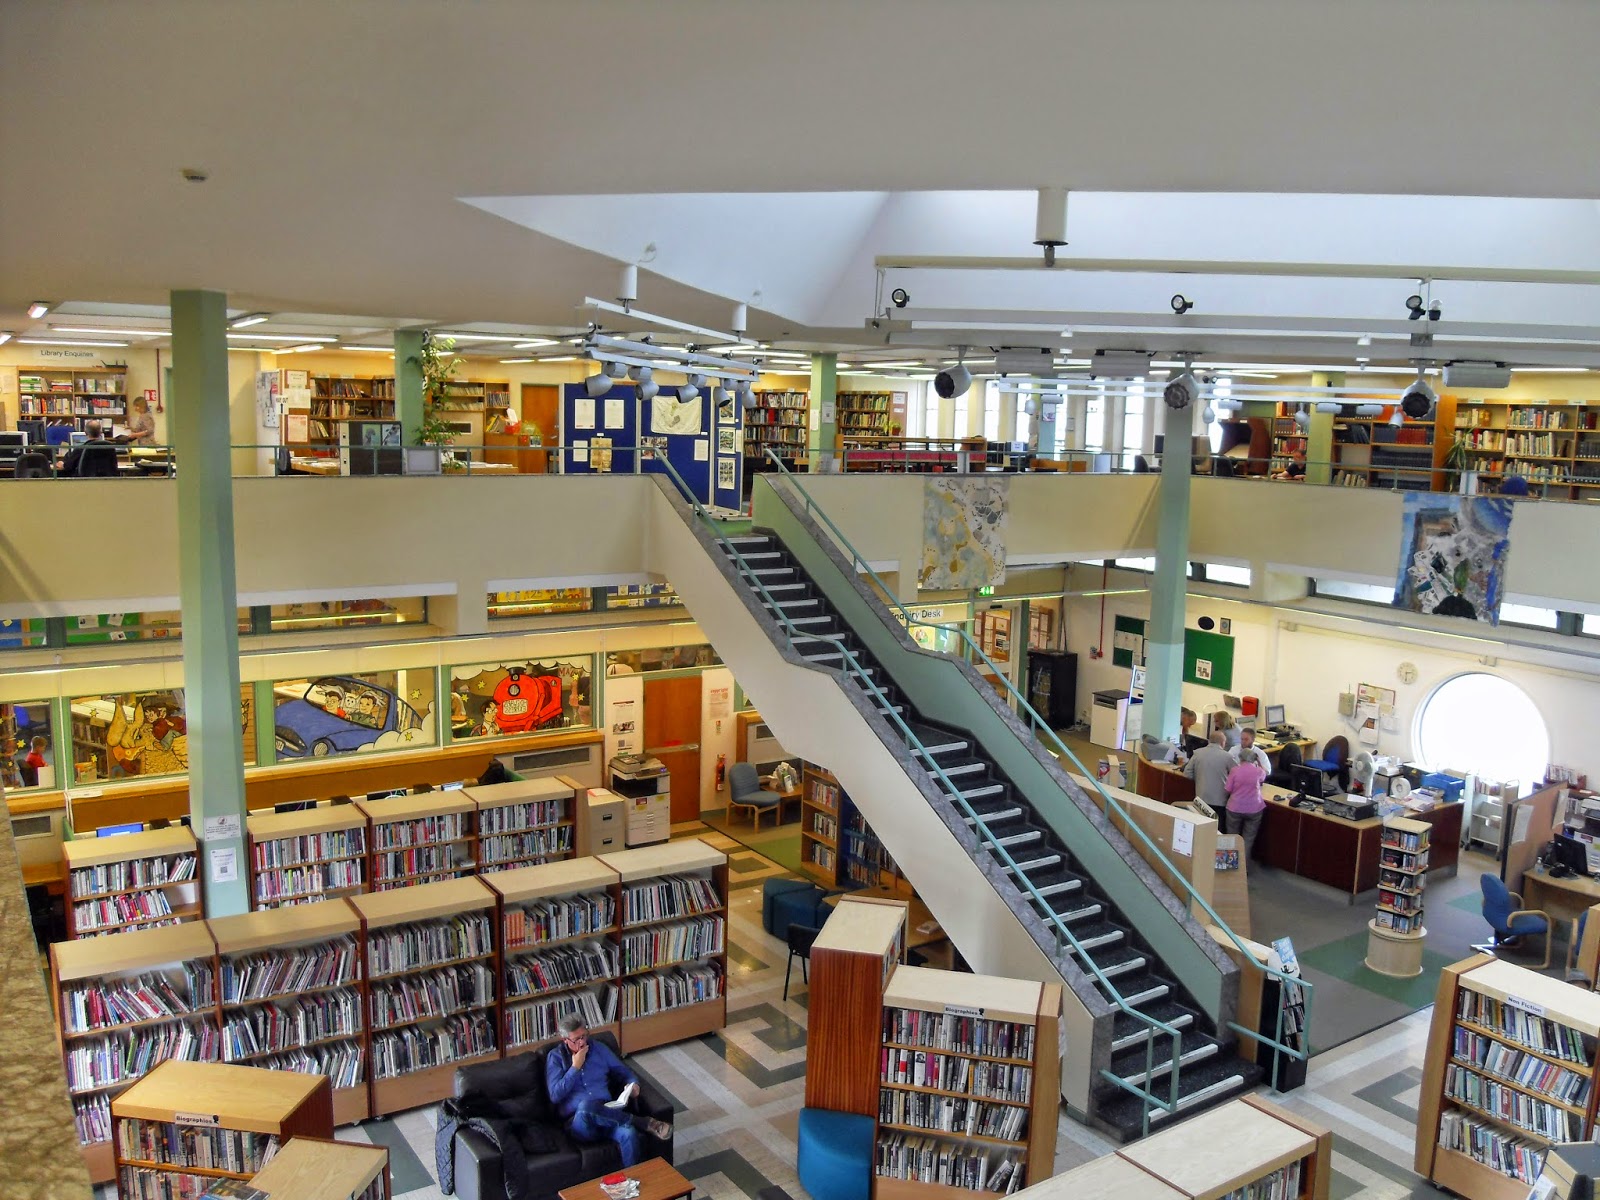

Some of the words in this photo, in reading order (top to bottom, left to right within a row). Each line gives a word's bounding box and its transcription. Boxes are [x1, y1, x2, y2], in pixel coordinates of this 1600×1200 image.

[40, 349, 63, 358] Library
[64, 350, 94, 358] Enquiries
[921, 609, 941, 618] Desk
[1508, 996, 1520, 1005] Non
[1521, 1001, 1542, 1013] Fiction
[945, 1006, 978, 1016] Biographies
[176, 1115, 213, 1124] Biographies
